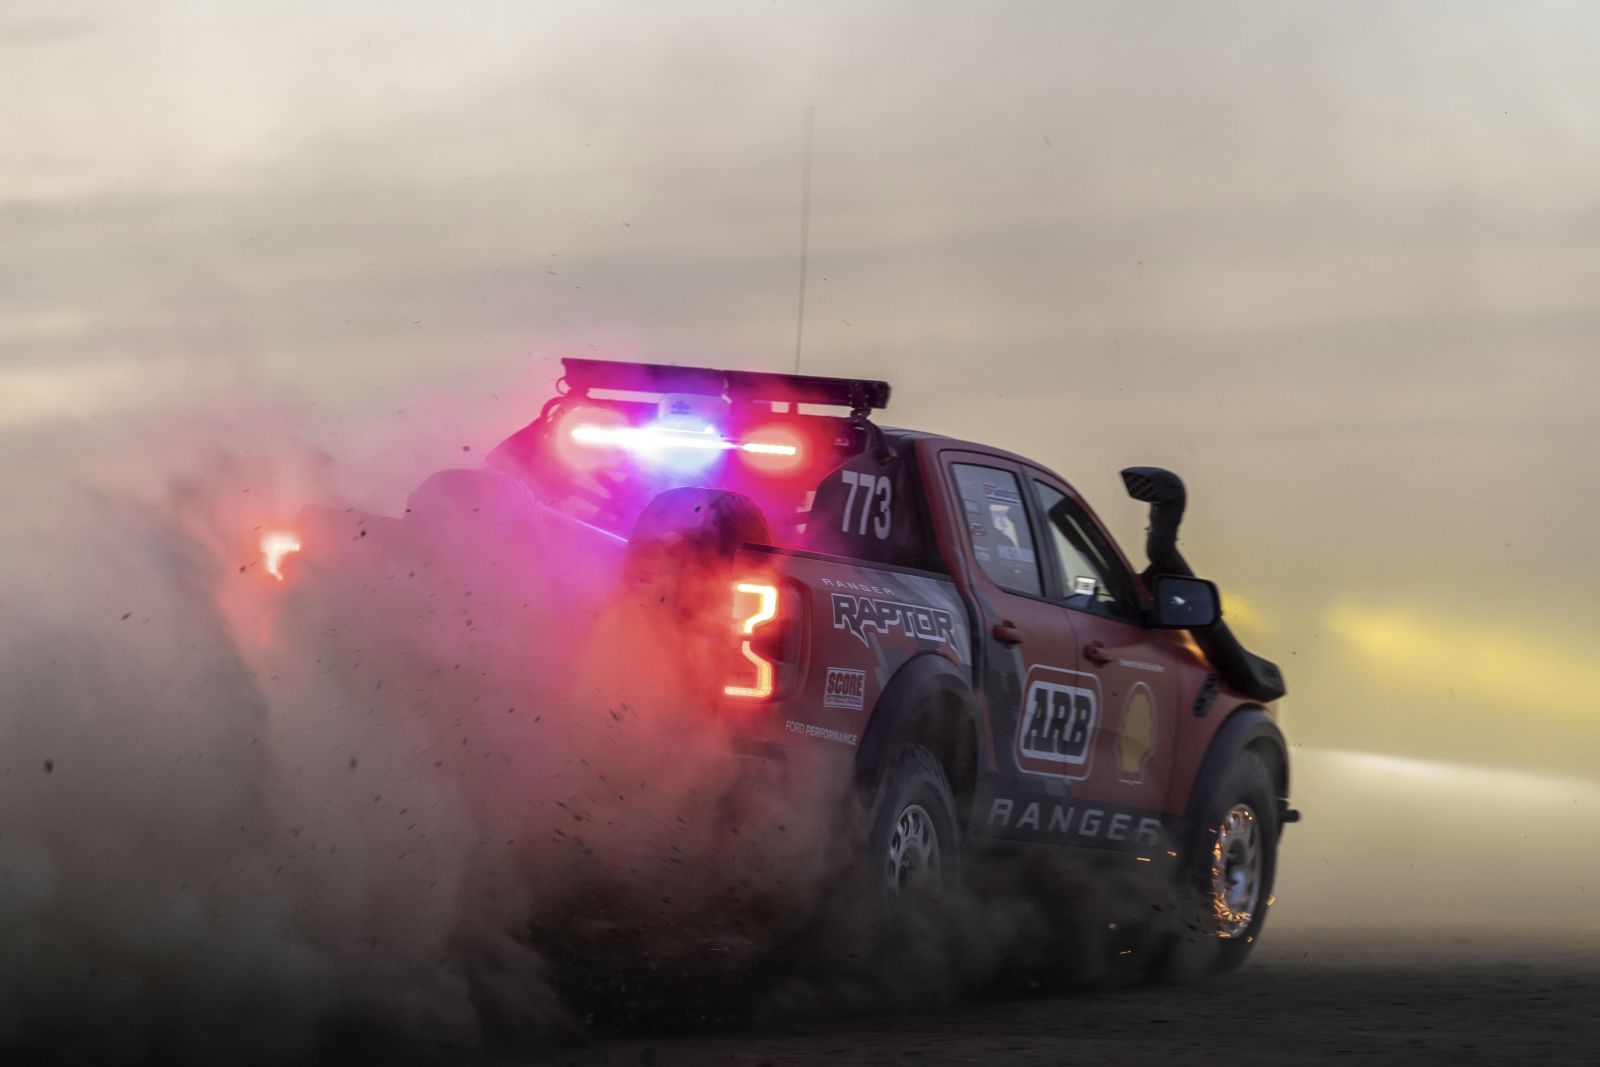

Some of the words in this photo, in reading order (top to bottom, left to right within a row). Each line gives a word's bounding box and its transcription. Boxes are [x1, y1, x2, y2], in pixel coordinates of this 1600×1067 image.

[841, 470, 892, 540] 773
[821, 577, 896, 597] RANGER
[831, 592, 962, 662] RAPTOR
[827, 672, 864, 697] SCORE
[785, 720, 805, 735] FORD
[805, 725, 858, 746] PERFORMANCE
[1023, 686, 1093, 757] ARB
[988, 798, 1161, 846] RANGER
